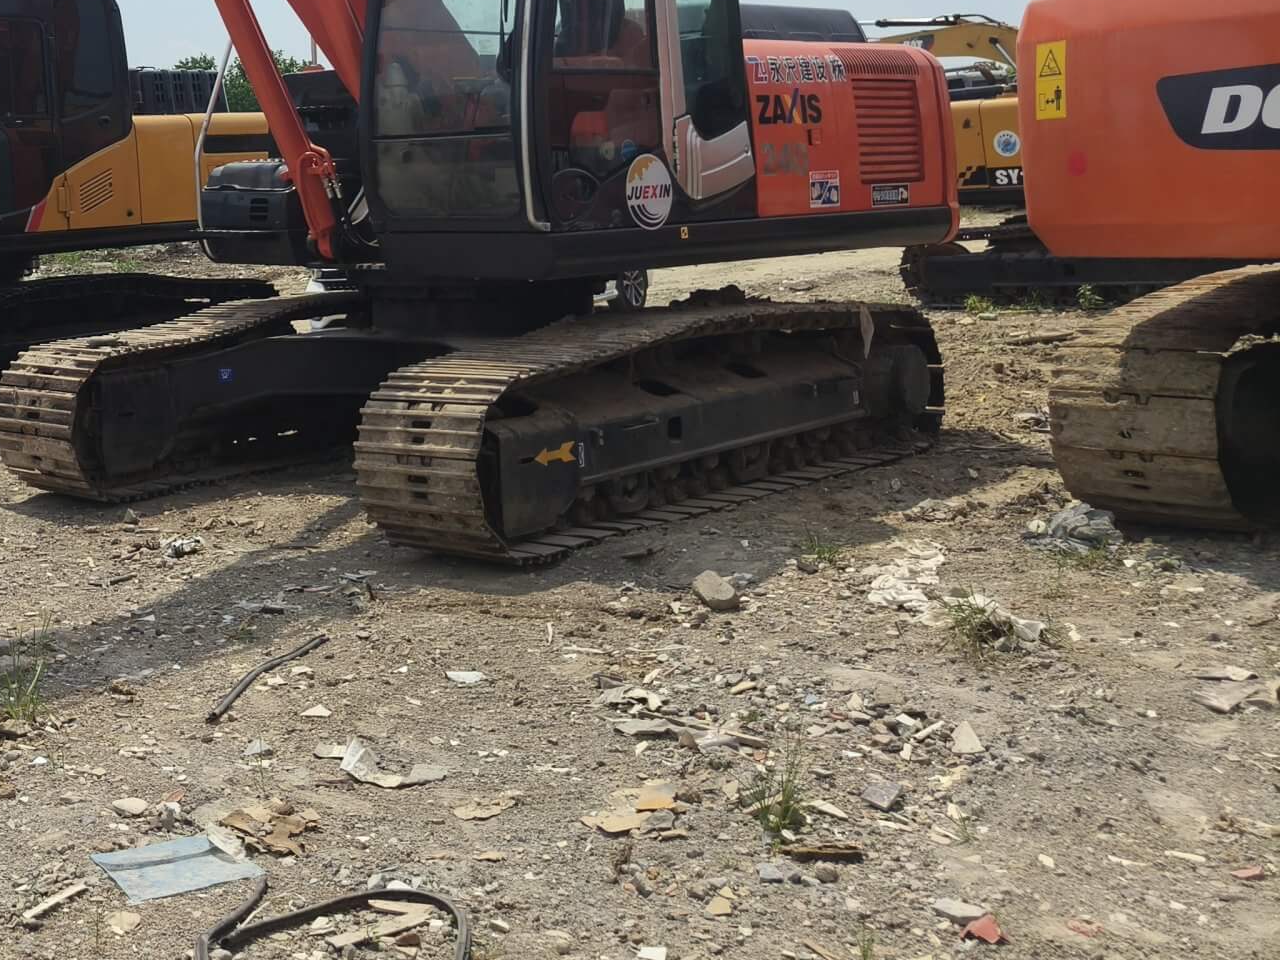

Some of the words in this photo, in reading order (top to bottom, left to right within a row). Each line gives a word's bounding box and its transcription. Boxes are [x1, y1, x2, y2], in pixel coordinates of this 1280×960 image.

[756, 87, 823, 125] ZAXIS
[1200, 83, 1280, 135] D
[995, 167, 1024, 185] SY
[627, 183, 671, 201] JUEXIN
